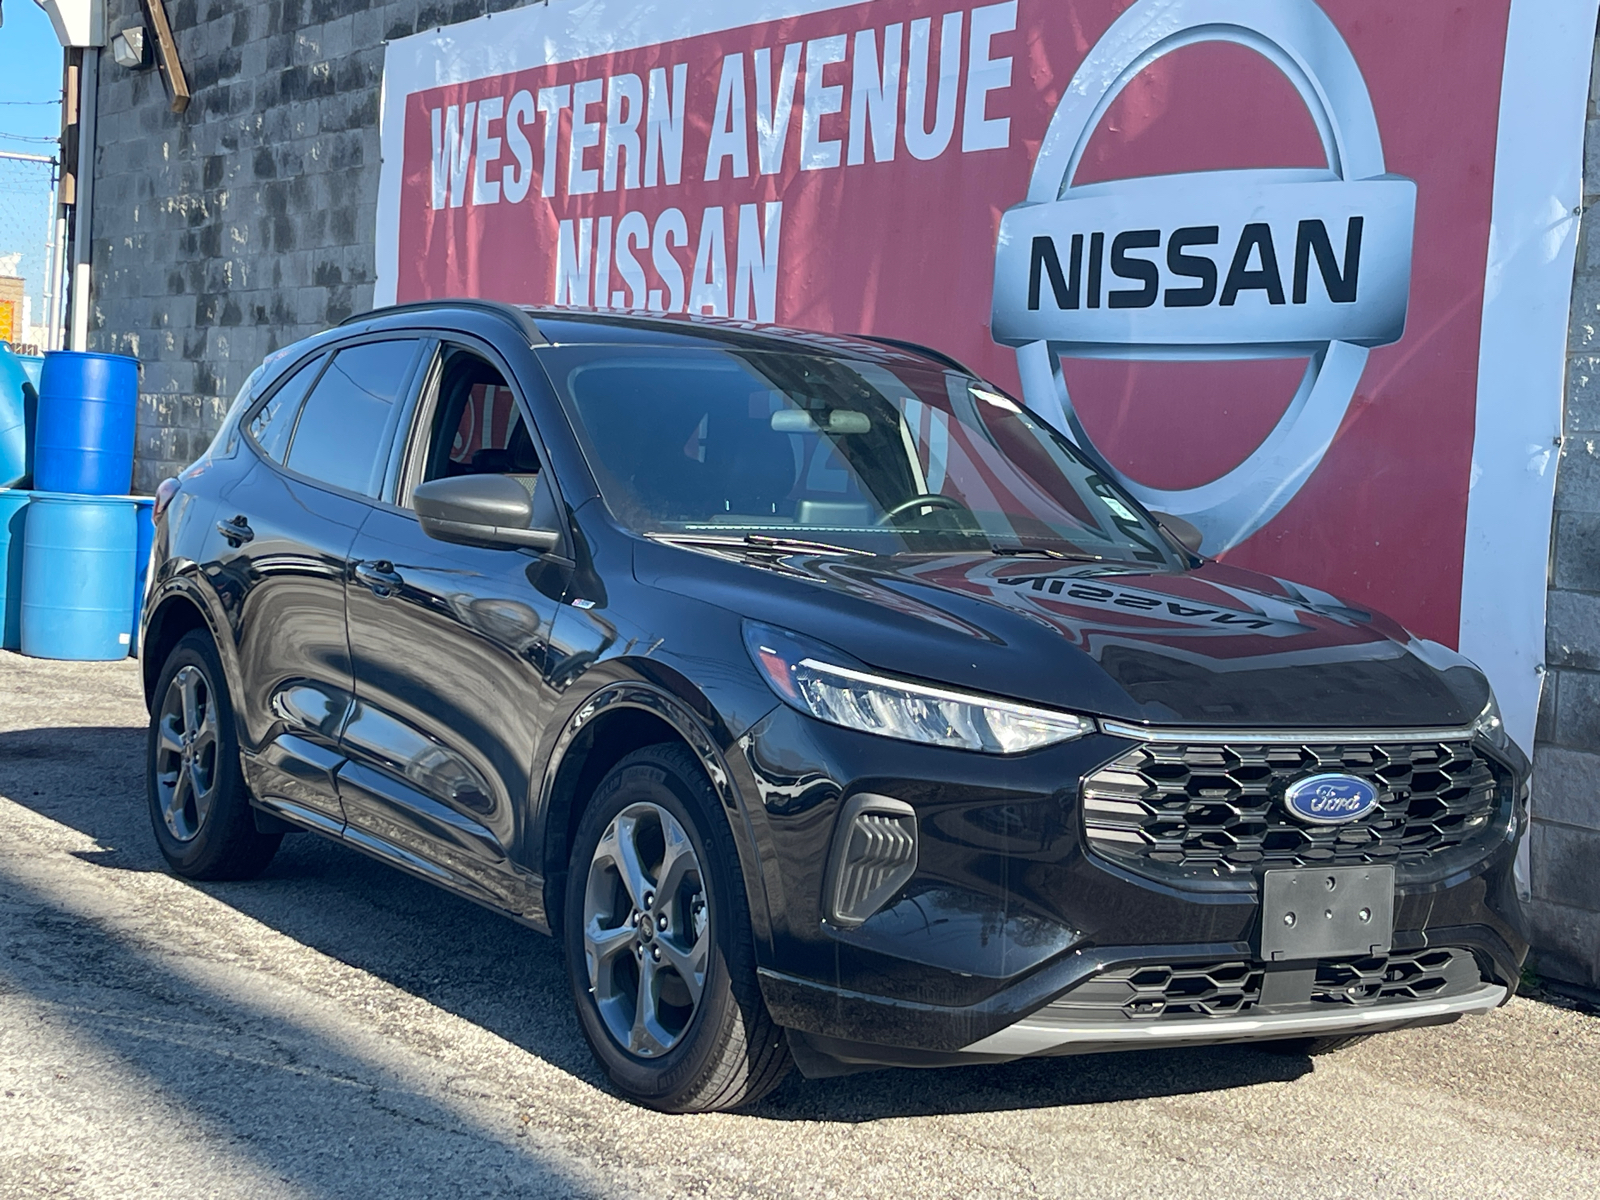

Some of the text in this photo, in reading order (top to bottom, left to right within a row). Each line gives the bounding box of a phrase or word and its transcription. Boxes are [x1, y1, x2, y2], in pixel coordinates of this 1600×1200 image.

[430, 0, 1018, 211] WESTERN AVENUE
[554, 201, 783, 324] NISSAN
[1027, 216, 1364, 310] NISSAN
[1310, 784, 1362, 812] Ford
